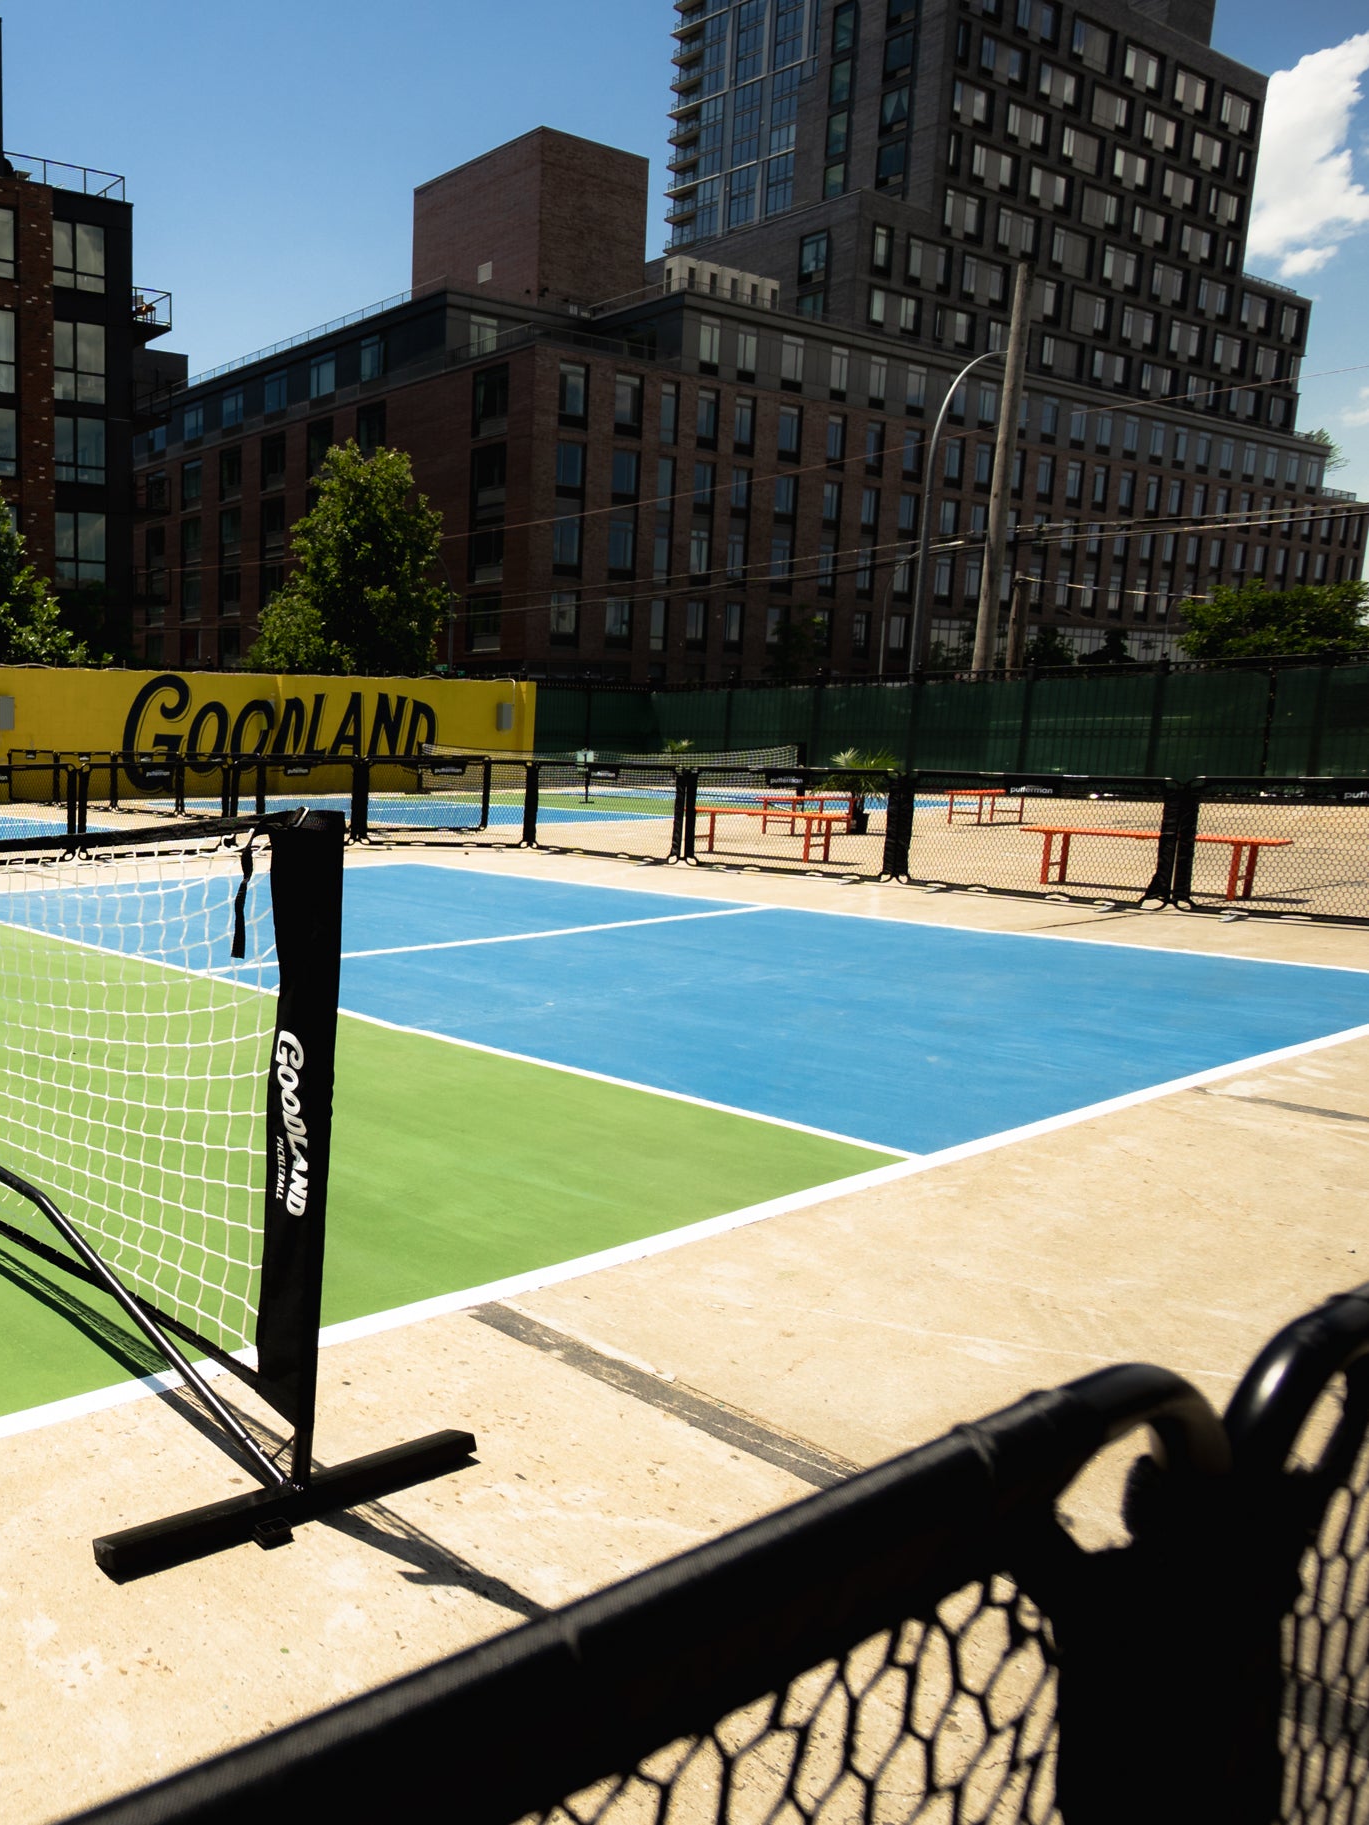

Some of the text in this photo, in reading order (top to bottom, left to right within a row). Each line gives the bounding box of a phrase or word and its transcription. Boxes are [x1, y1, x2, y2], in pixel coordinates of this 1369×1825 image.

[122, 674, 439, 794] GOODLAND
[1010, 786, 1053, 794] putterman
[276, 1030, 309, 1216] GOODLAND
[276, 1136, 286, 1200] PICKLEBALL
